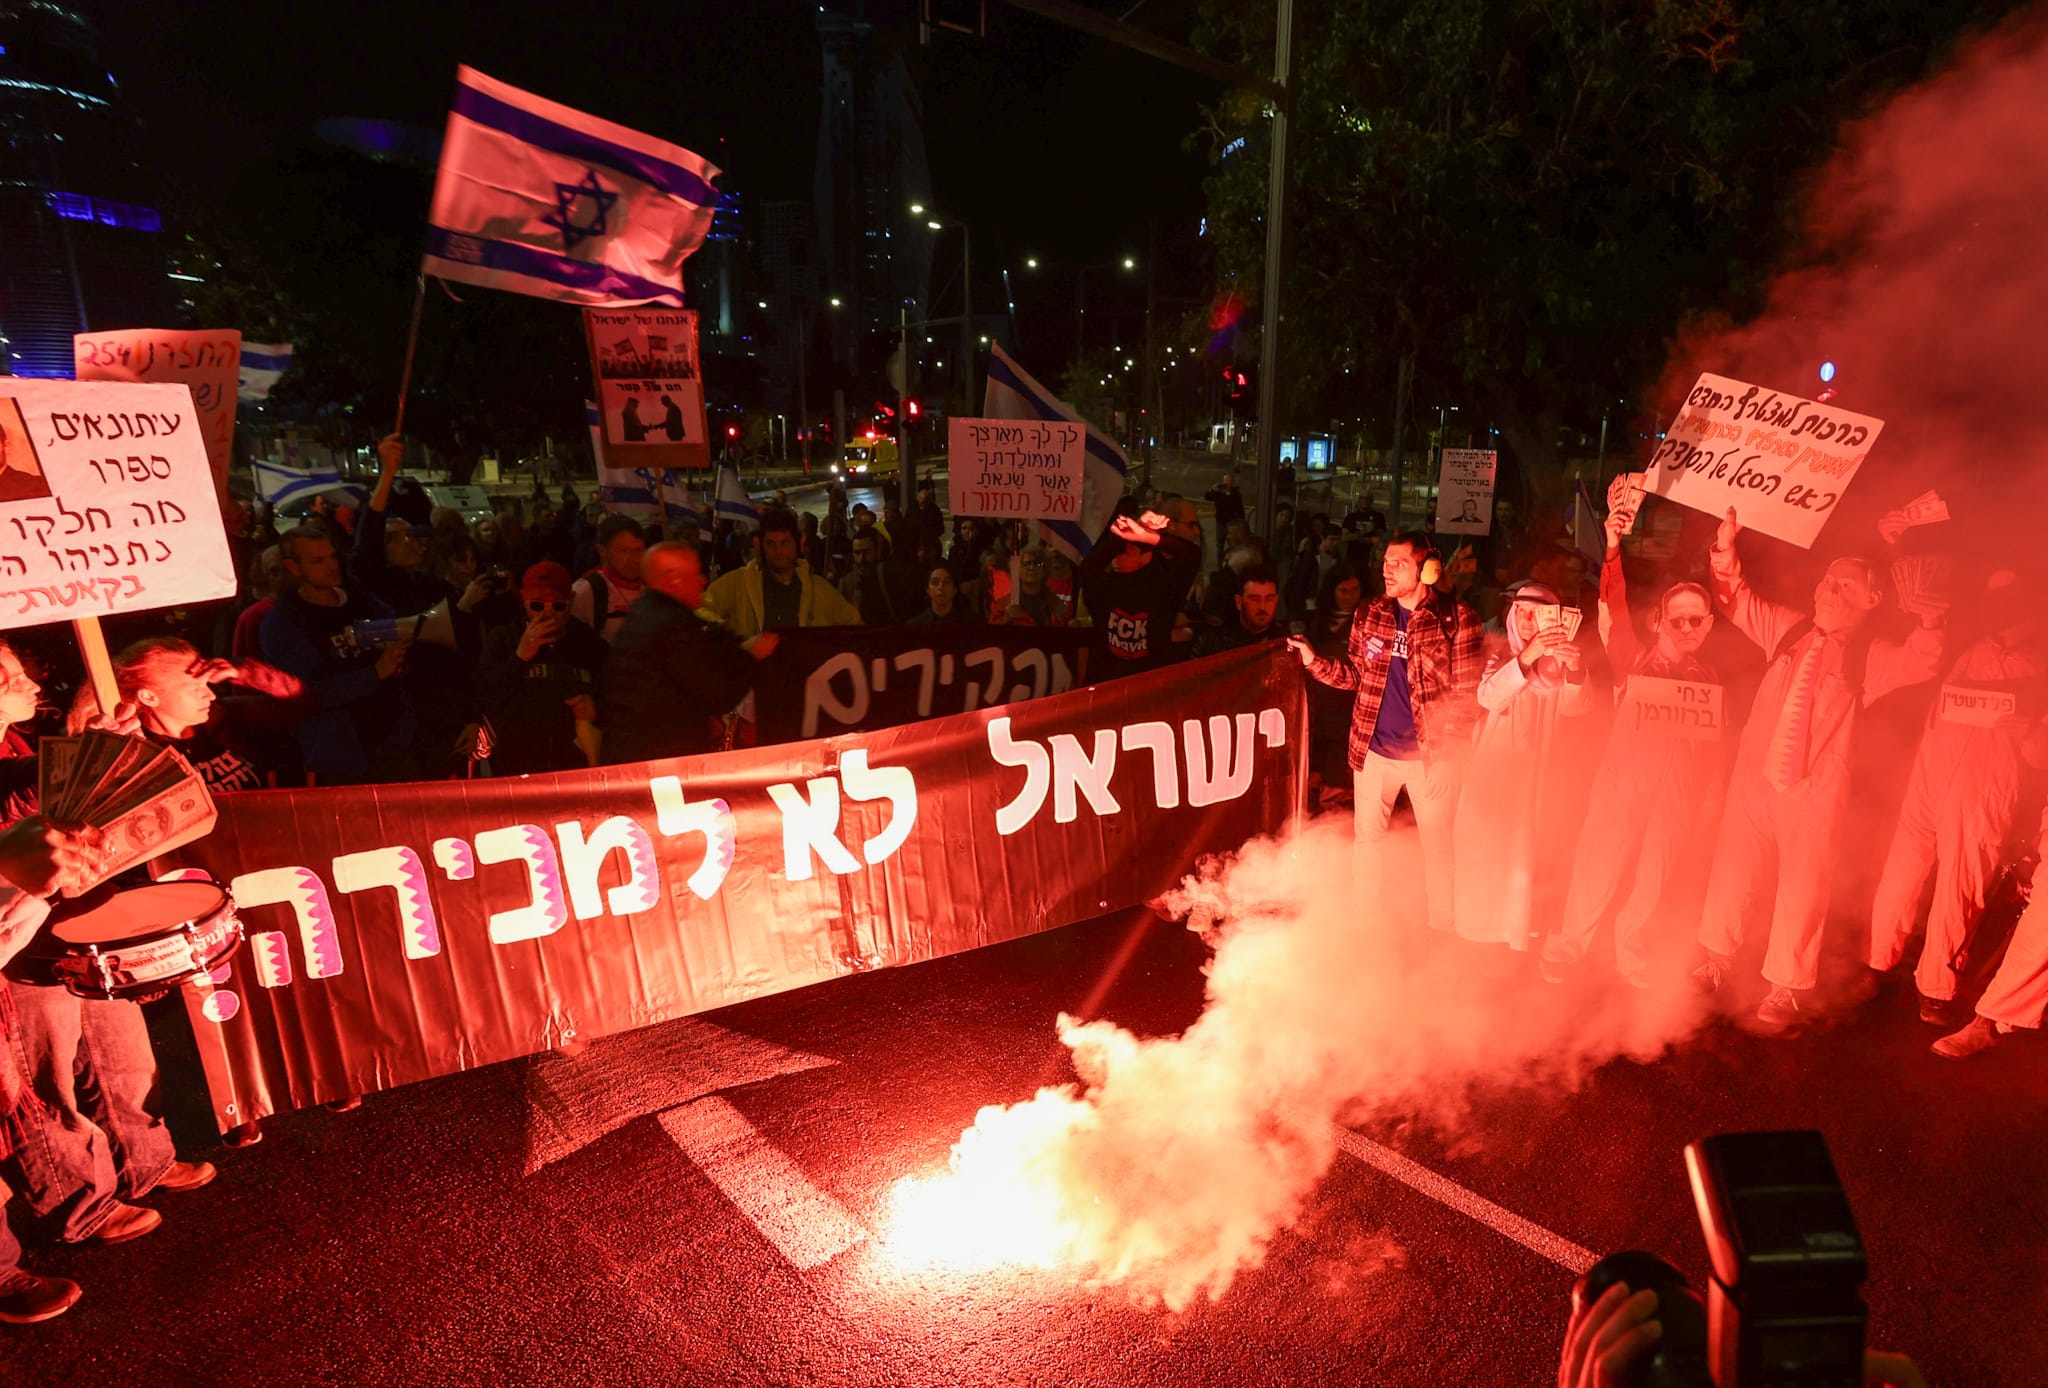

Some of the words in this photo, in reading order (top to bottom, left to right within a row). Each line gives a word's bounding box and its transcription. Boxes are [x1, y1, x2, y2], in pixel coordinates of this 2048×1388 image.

[592, 314, 630, 326] ישראל
[634, 313, 653, 326] של
[656, 315, 689, 326] אנחנו
[79, 341, 131, 368] 254
[1688, 385, 1735, 411] החדש
[48, 412, 181, 447] עיתונאים,
[1791, 414, 1869, 447] ברכות
[90, 455, 172, 484] ספרו
[1650, 439, 1714, 475] הסנדק
[1708, 448, 1741, 479] של
[1728, 455, 1782, 495] הסגל
[132, 500, 187, 527] מה
[1784, 485, 1837, 512] ראש
[10, 496, 112, 548] חלקו
[48, 540, 172, 572] נתניהו
[1108, 611, 1148, 639] FCK
[1677, 685, 1711, 704] צחי
[1635, 701, 1718, 732] ברוורמן
[987, 707, 1286, 836] ישראל
[766, 749, 918, 881] לא
